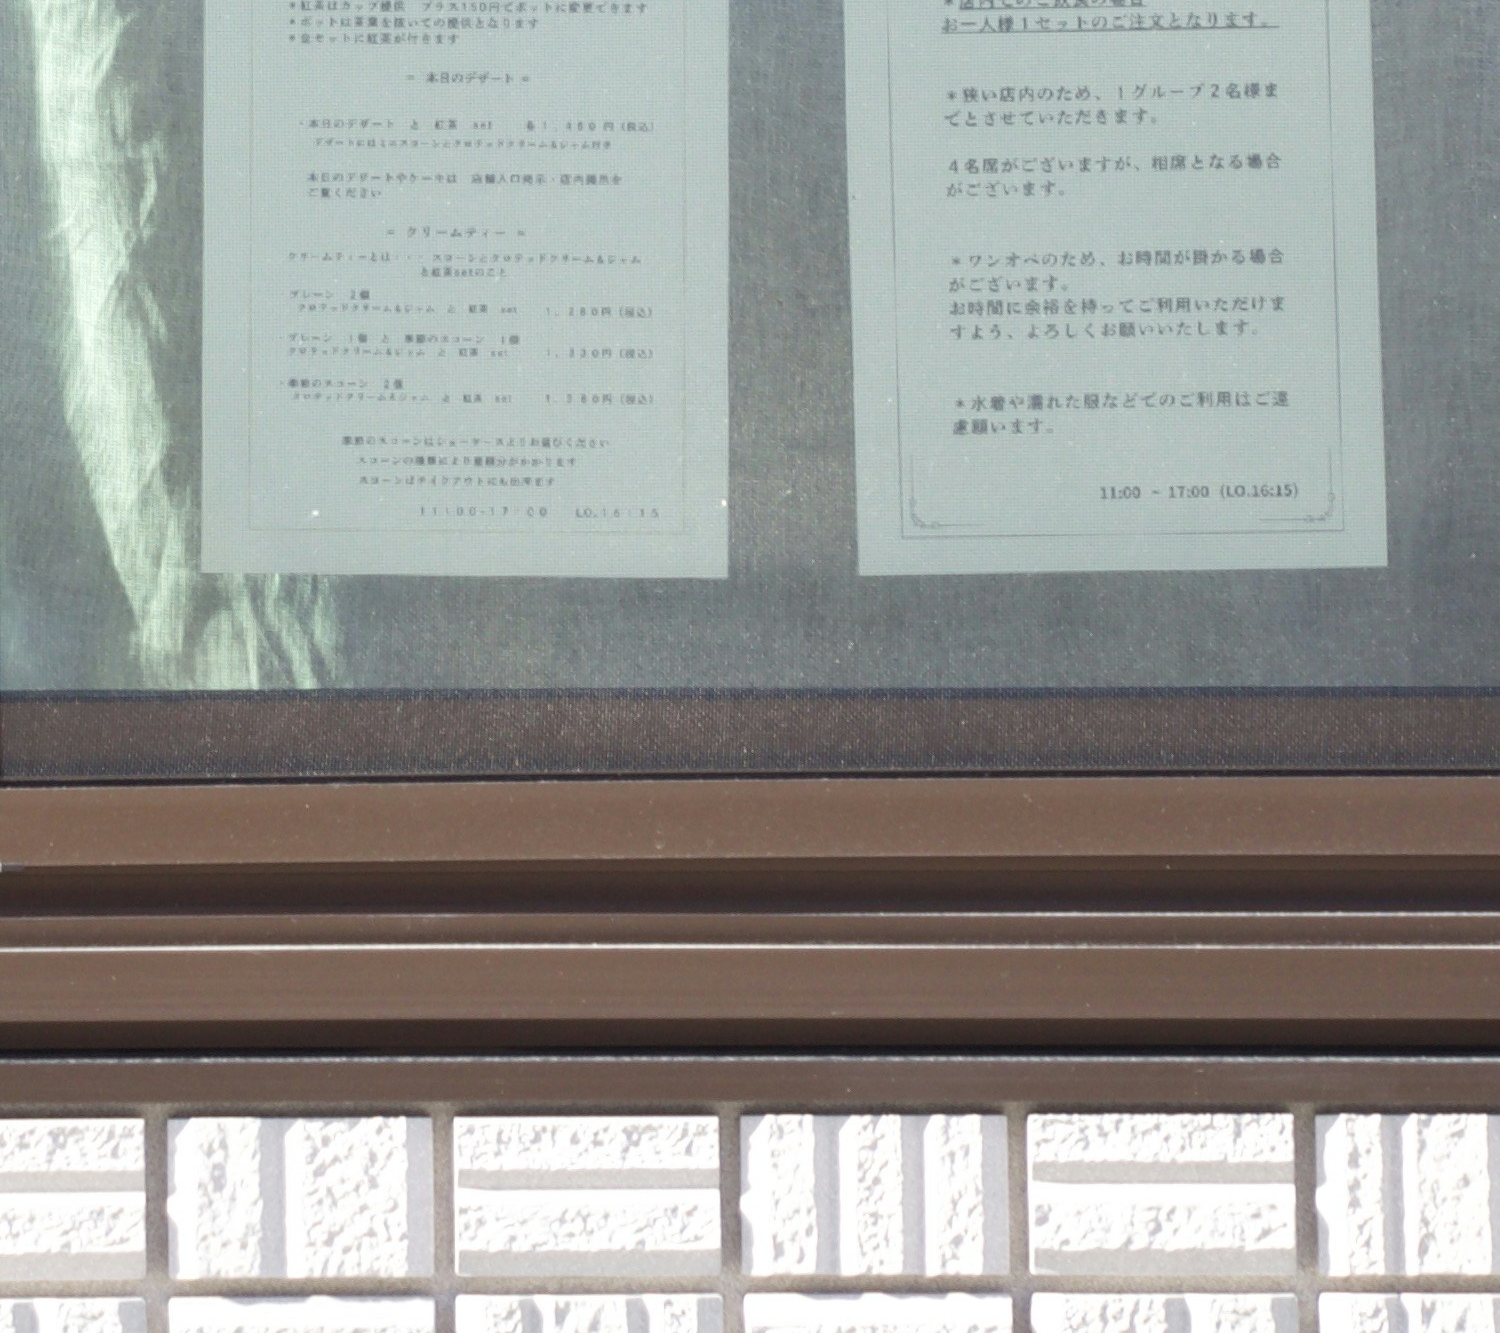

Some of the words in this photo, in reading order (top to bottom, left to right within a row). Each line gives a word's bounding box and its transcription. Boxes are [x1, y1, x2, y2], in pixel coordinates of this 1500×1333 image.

[944, 109, 1157, 127] でとさせていただきます。
[946, 181, 1065, 198] がございます。
[949, 275, 1068, 293] がございます。
[950, 296, 1285, 317] お時間に余裕を持ってご利用いただけま
[951, 319, 1258, 340] すよう、よろしくお願いいたします。
[1100, 485, 1141, 500] 11:00
[1168, 485, 1210, 499] 17:00
